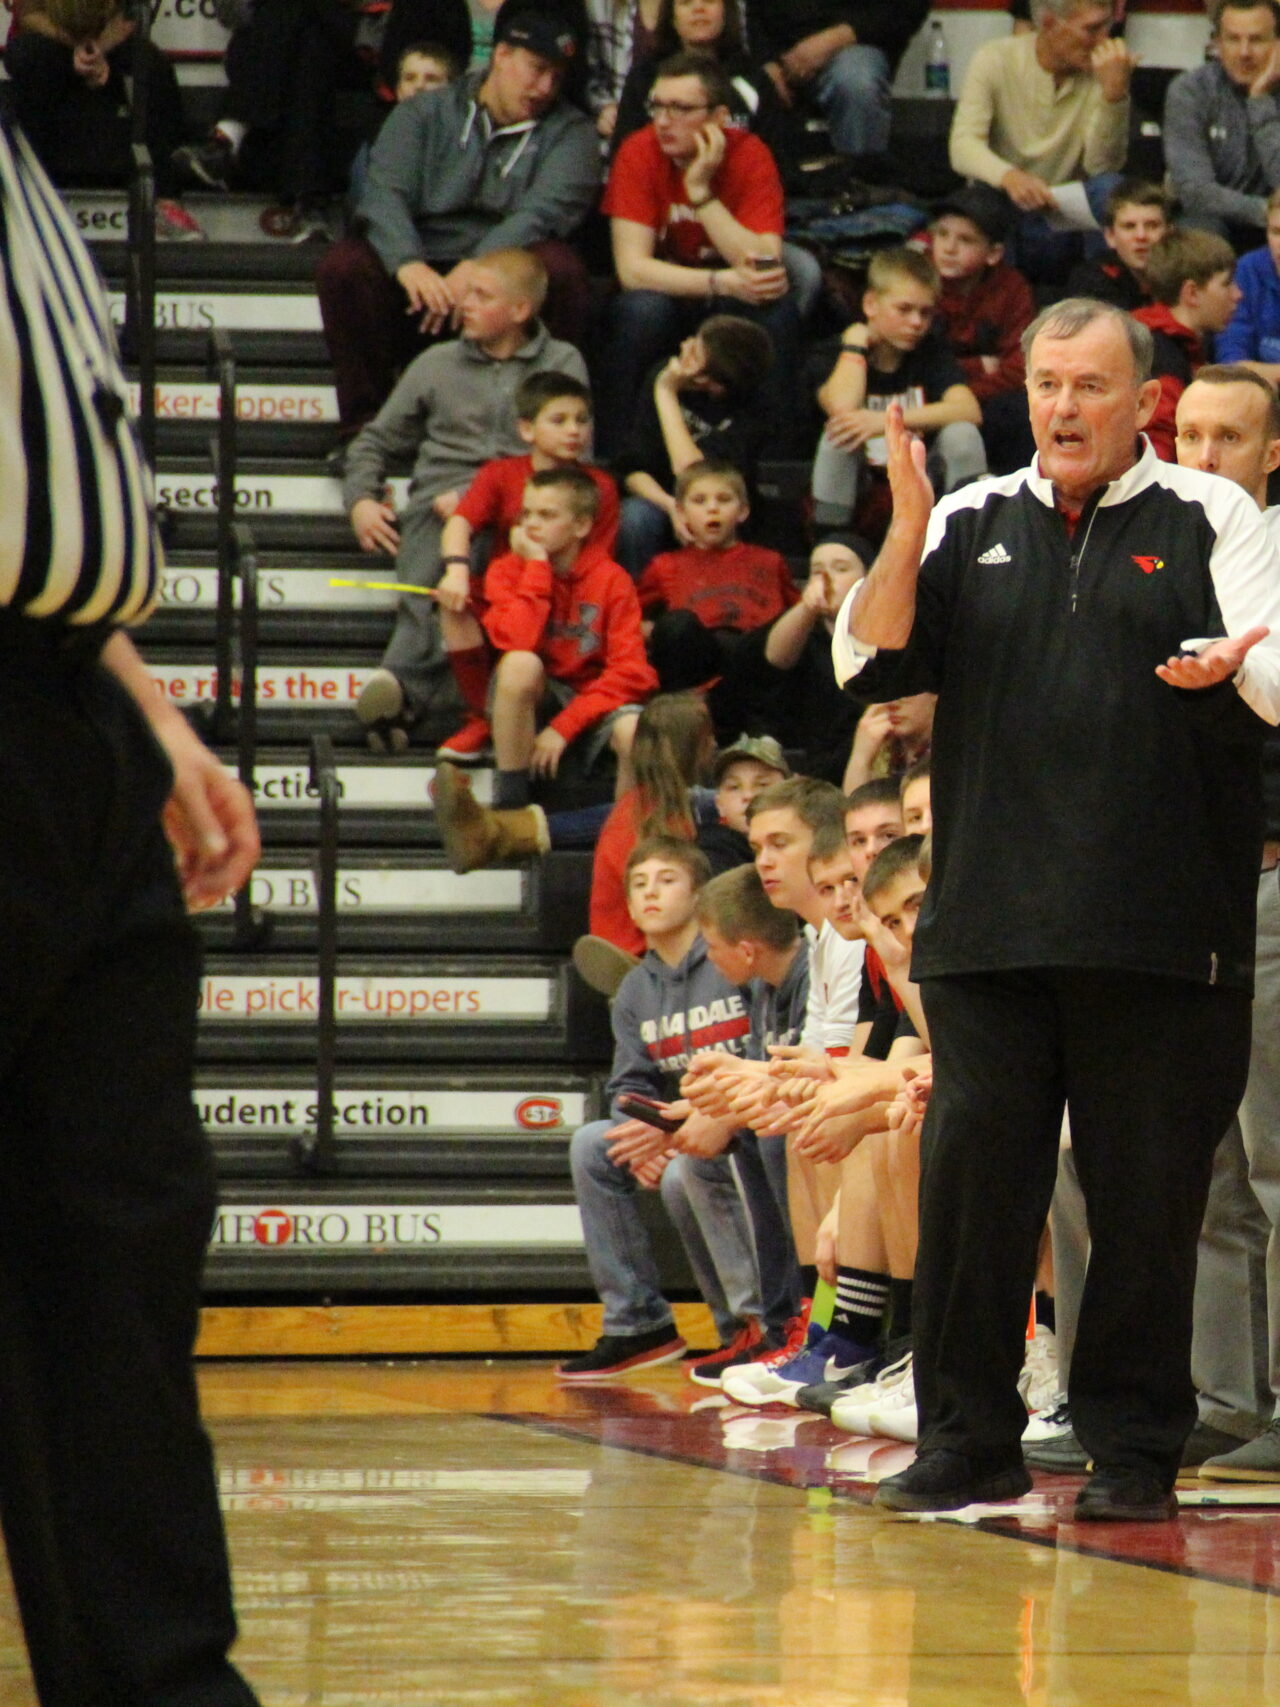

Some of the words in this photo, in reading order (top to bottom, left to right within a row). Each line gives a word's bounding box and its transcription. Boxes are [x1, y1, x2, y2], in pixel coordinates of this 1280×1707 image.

[160, 485, 272, 508] secton
[285, 672, 338, 699] the
[246, 981, 481, 1016] pickr-uppers
[198, 1096, 296, 1124] udent
[305, 1097, 429, 1125] sction
[365, 1213, 442, 1245] BUS
